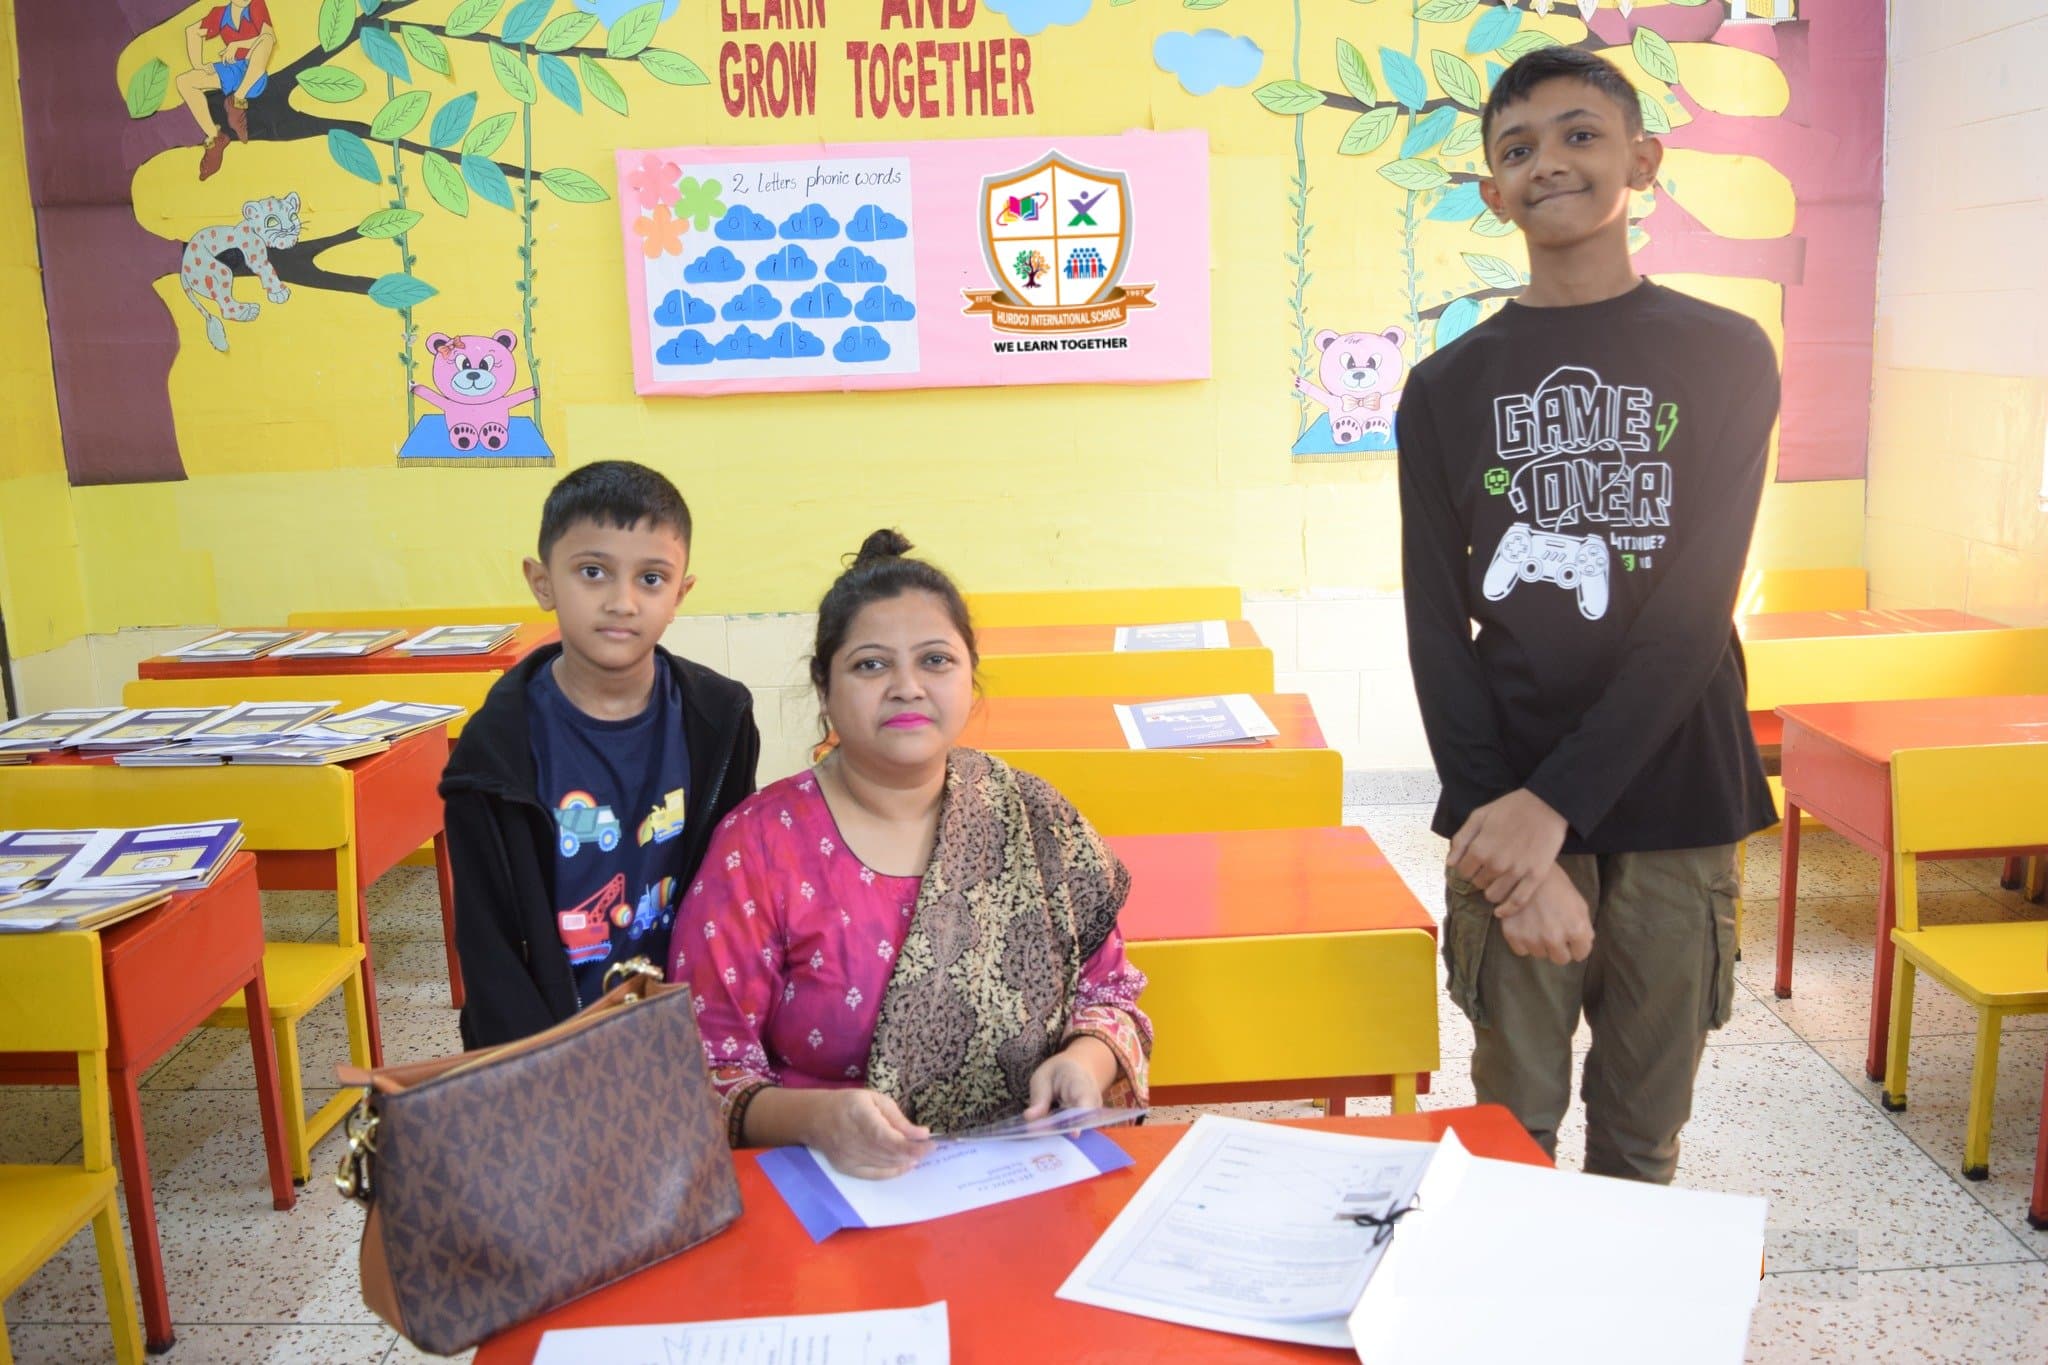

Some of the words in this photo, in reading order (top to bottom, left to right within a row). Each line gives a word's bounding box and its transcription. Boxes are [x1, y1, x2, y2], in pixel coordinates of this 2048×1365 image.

[719, 41, 816, 117] GROW
[846, 38, 1034, 119] TOGETHER
[733, 174, 749, 194] 2
[806, 166, 849, 197] phonic
[855, 168, 902, 186] words
[1031, 312, 1090, 326] INTERNATIONAL
[1091, 307, 1122, 323] SCHOOL
[994, 342, 1014, 353] WE
[1016, 340, 1058, 352] LEARN
[1060, 337, 1128, 350] TOGETHER
[1494, 385, 1653, 459] GAME
[1532, 459, 1672, 528] OVER
